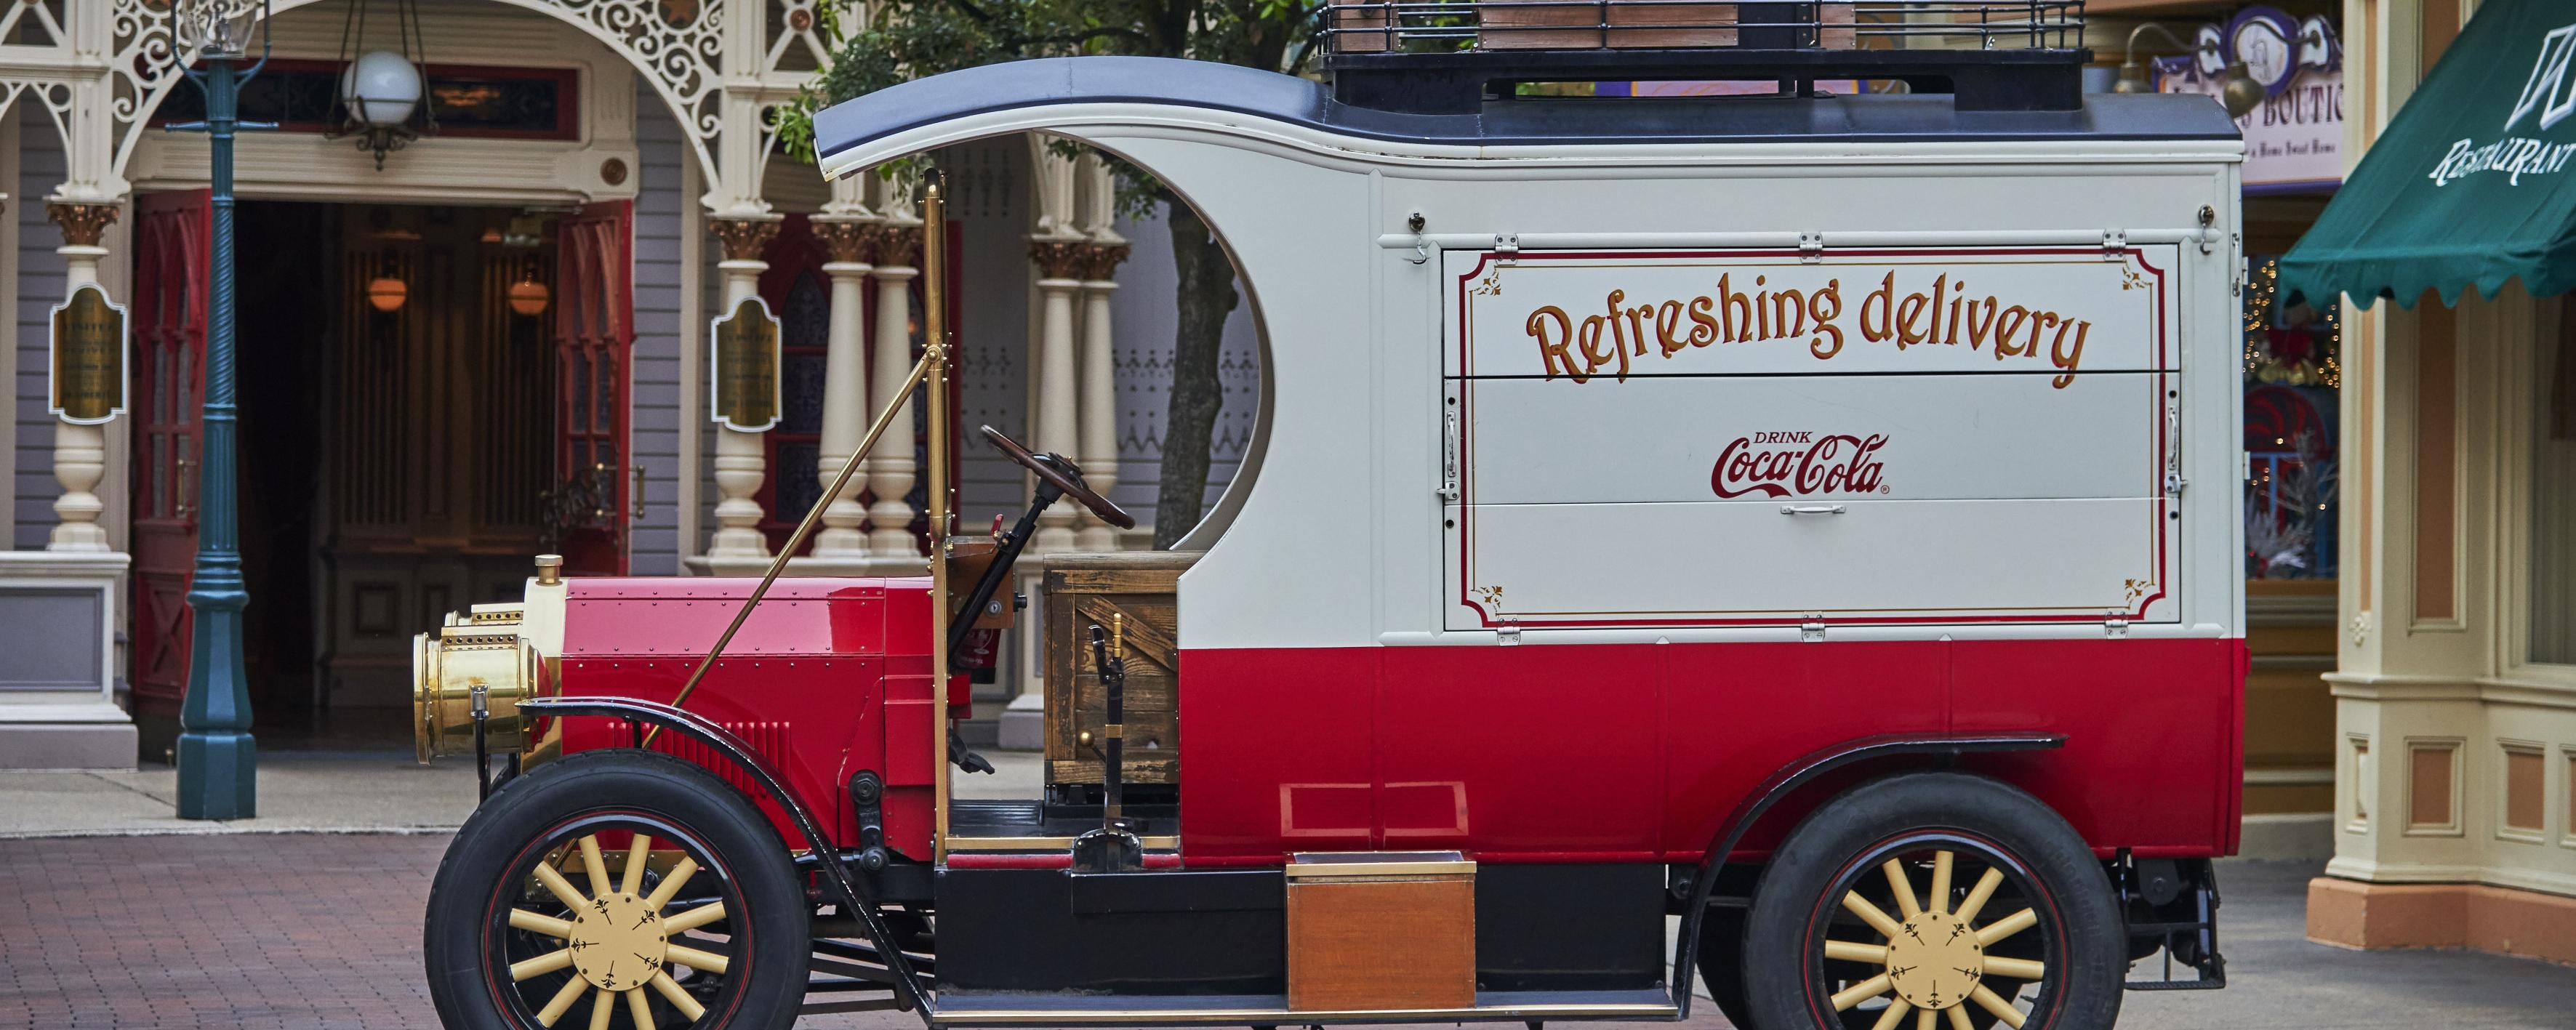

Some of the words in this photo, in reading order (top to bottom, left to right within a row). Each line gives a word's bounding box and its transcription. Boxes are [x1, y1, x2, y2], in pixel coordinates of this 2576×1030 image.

[1527, 272, 1844, 384] Refreshing
[1860, 269, 2092, 389] delivery
[1711, 434, 1890, 499] Coca-Cola
[1753, 431, 1813, 443] DRINK
